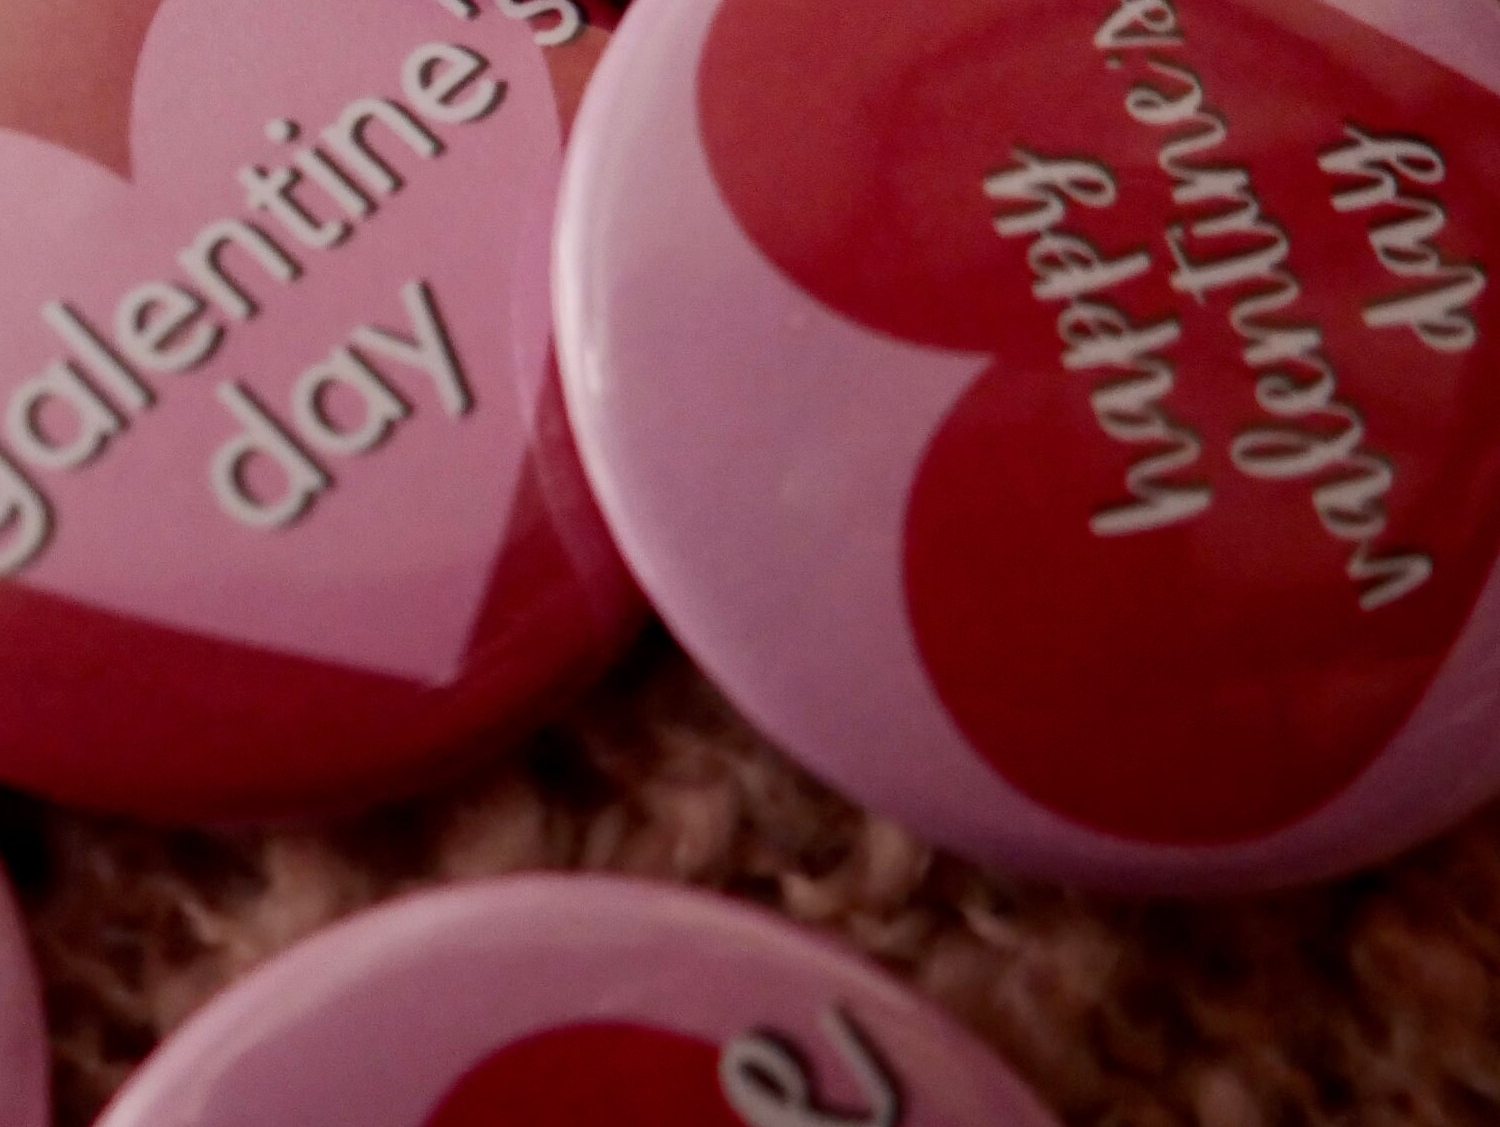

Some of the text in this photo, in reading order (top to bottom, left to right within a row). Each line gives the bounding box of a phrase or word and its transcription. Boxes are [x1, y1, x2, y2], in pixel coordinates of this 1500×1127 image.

[983, 140, 1214, 536] happy
[1318, 122, 1486, 353] day
[210, 278, 475, 530] day
